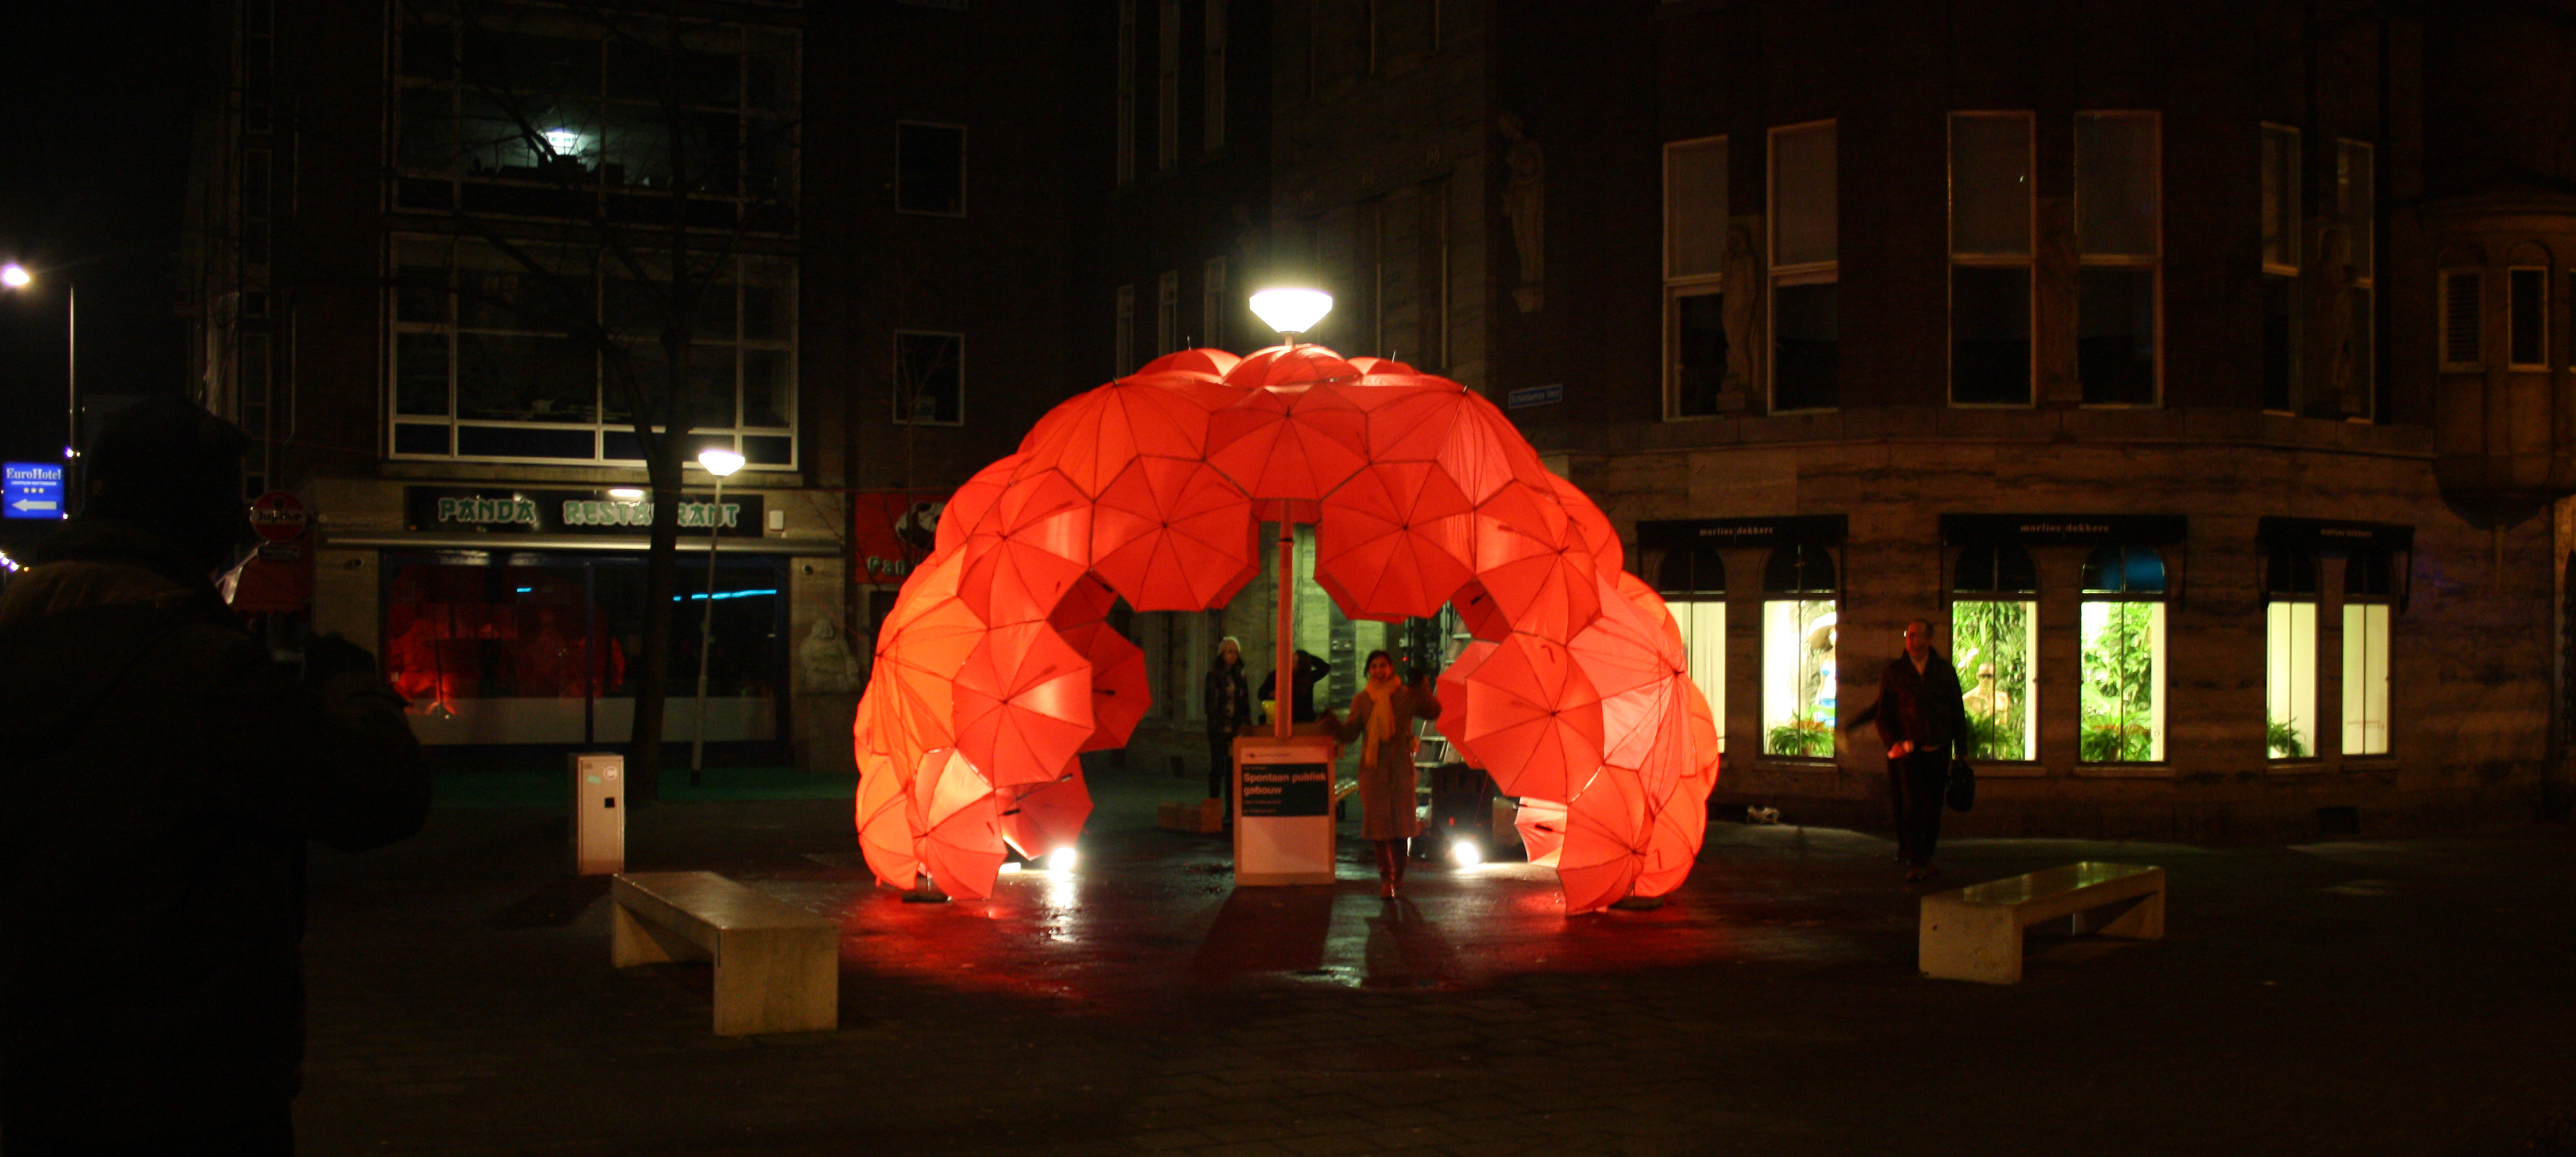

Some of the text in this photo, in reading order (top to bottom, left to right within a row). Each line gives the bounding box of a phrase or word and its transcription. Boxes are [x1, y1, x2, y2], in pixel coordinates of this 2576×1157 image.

[6, 467, 61, 480] EuroHotel
[438, 498, 740, 527] PANDA RESTARANT
[2021, 523, 2109, 532] marlies dekkers
[1244, 771, 1326, 785] Spontaan publiek
[1244, 786, 1282, 797] gebouw
